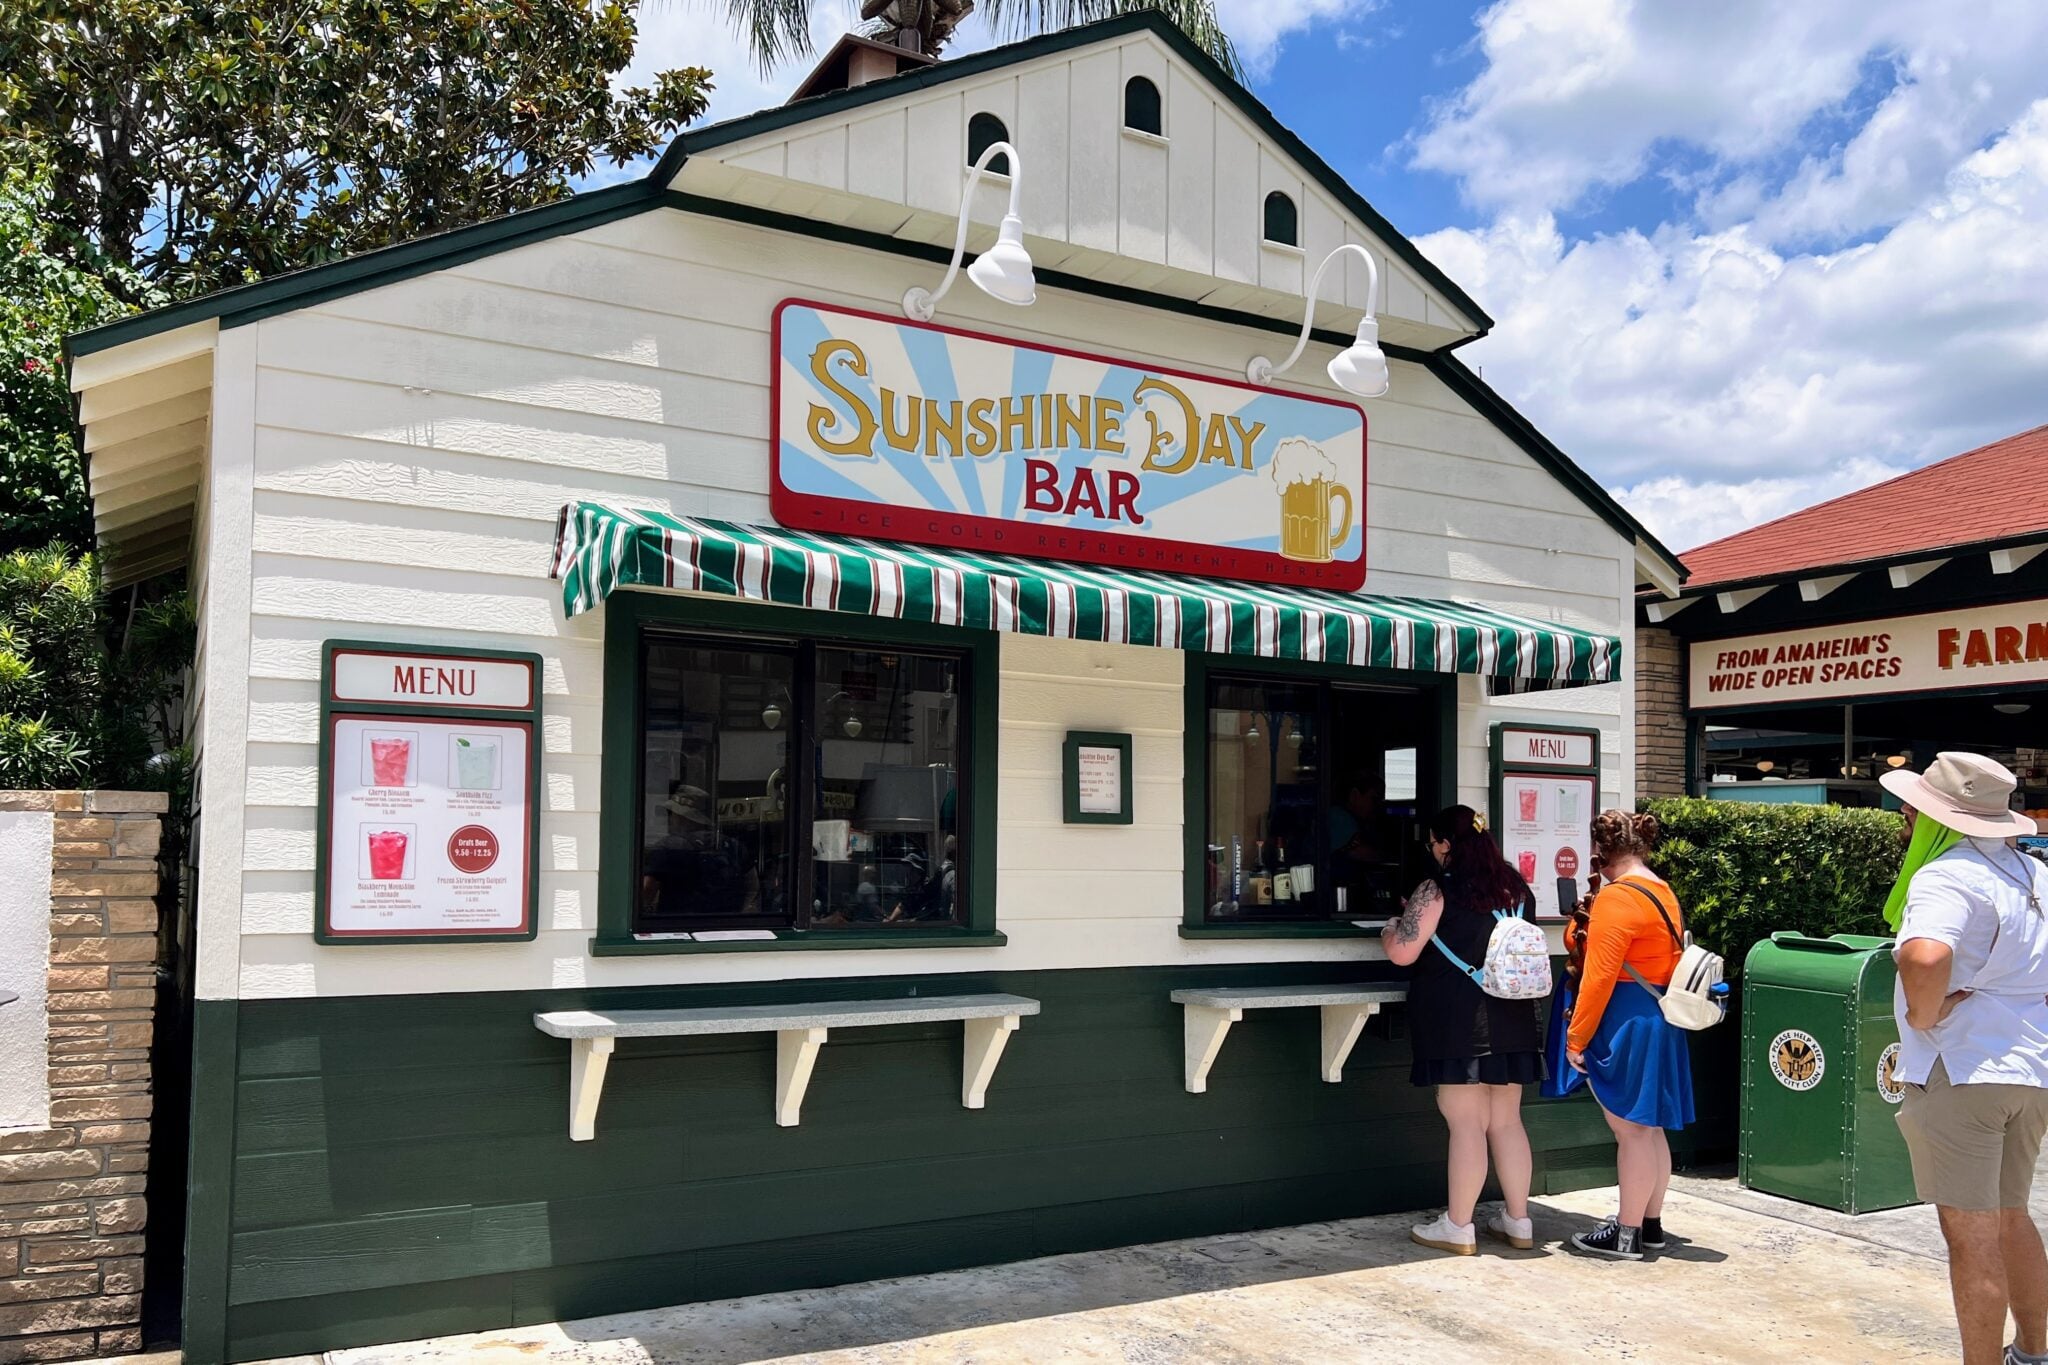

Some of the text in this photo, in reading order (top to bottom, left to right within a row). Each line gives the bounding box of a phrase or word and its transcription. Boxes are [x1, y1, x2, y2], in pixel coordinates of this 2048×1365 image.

[1133, 375, 1265, 474] DAY
[1024, 458, 1144, 524] BAR
[839, 510, 1323, 578] ICE COLD REFRESHMENT HERE
[1716, 633, 1891, 670] FROM ANAHEIM'S
[393, 665, 476, 697] MENU
[1709, 657, 1902, 692] WIDE OPEN SPACES
[1528, 738, 1566, 759] MENU
[1771, 1032, 1822, 1062] PLEASE HELP KEEP
[1772, 1061, 1821, 1088] OUR CITY CLEAN
